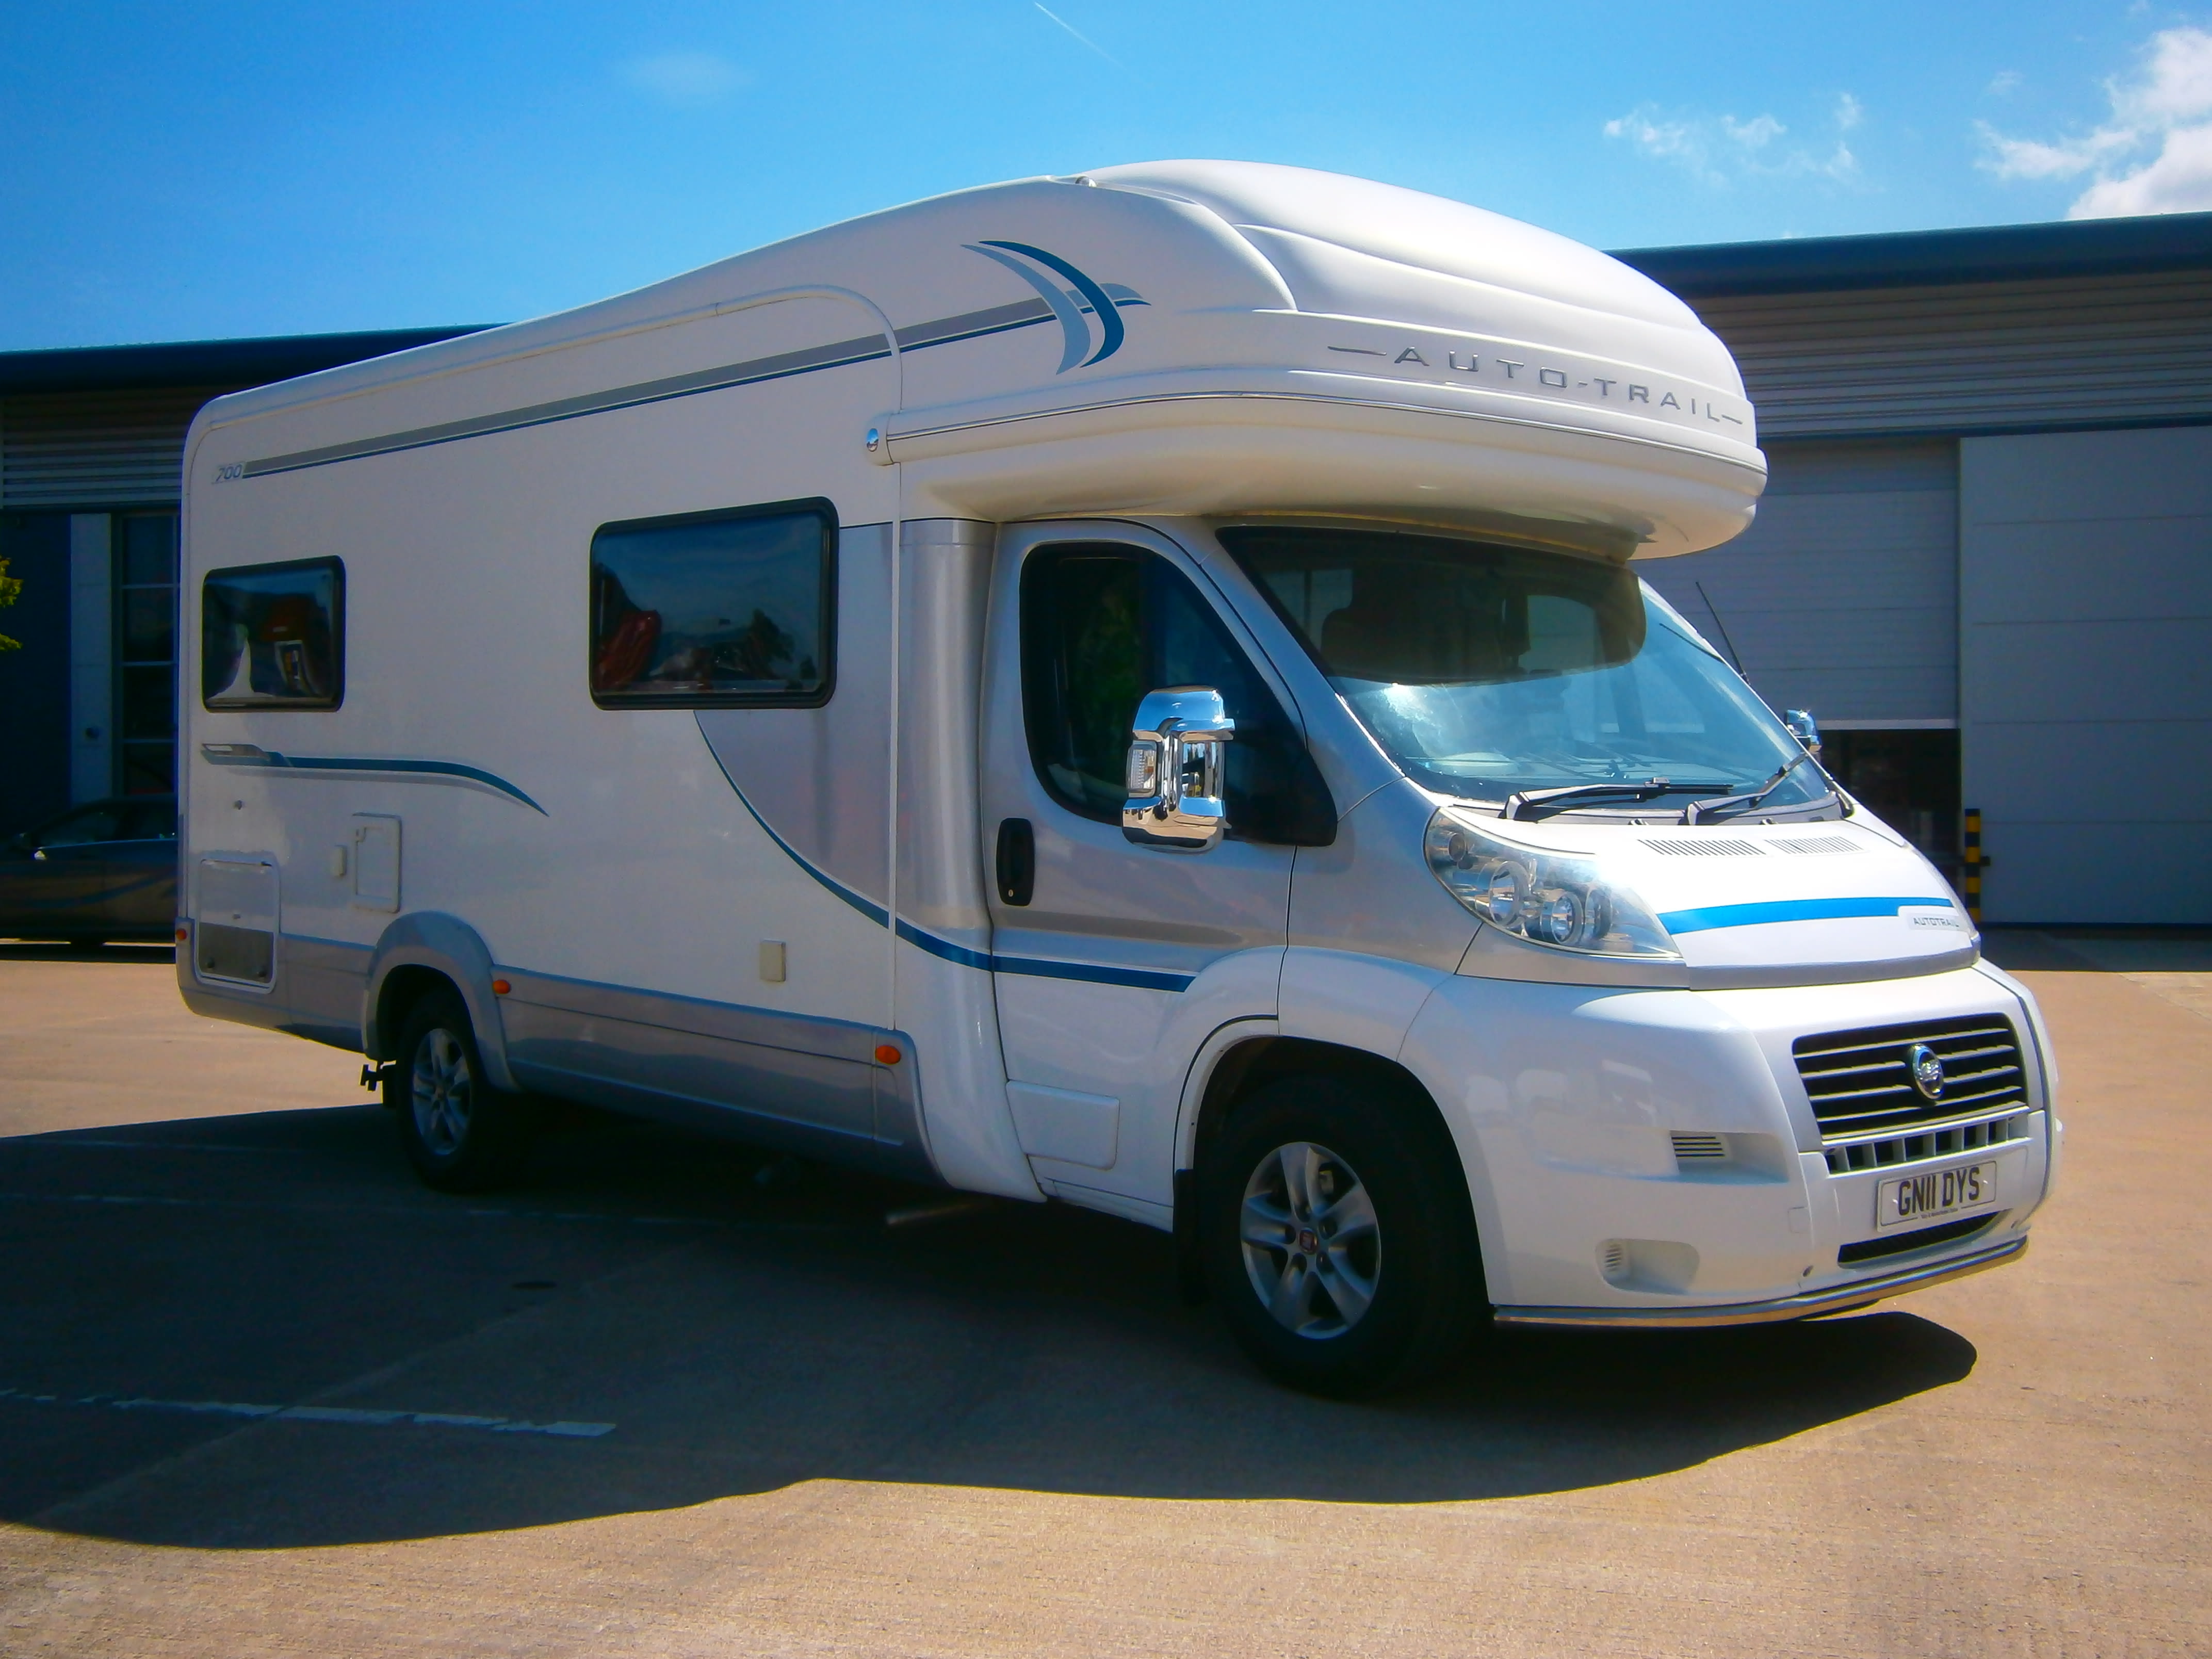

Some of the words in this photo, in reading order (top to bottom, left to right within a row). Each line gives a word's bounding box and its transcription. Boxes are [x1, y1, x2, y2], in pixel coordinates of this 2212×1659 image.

[1394, 346, 1720, 422] AUTO-TRAIL
[216, 464, 242, 482] 700
[1943, 1167, 1980, 1207] DYS
